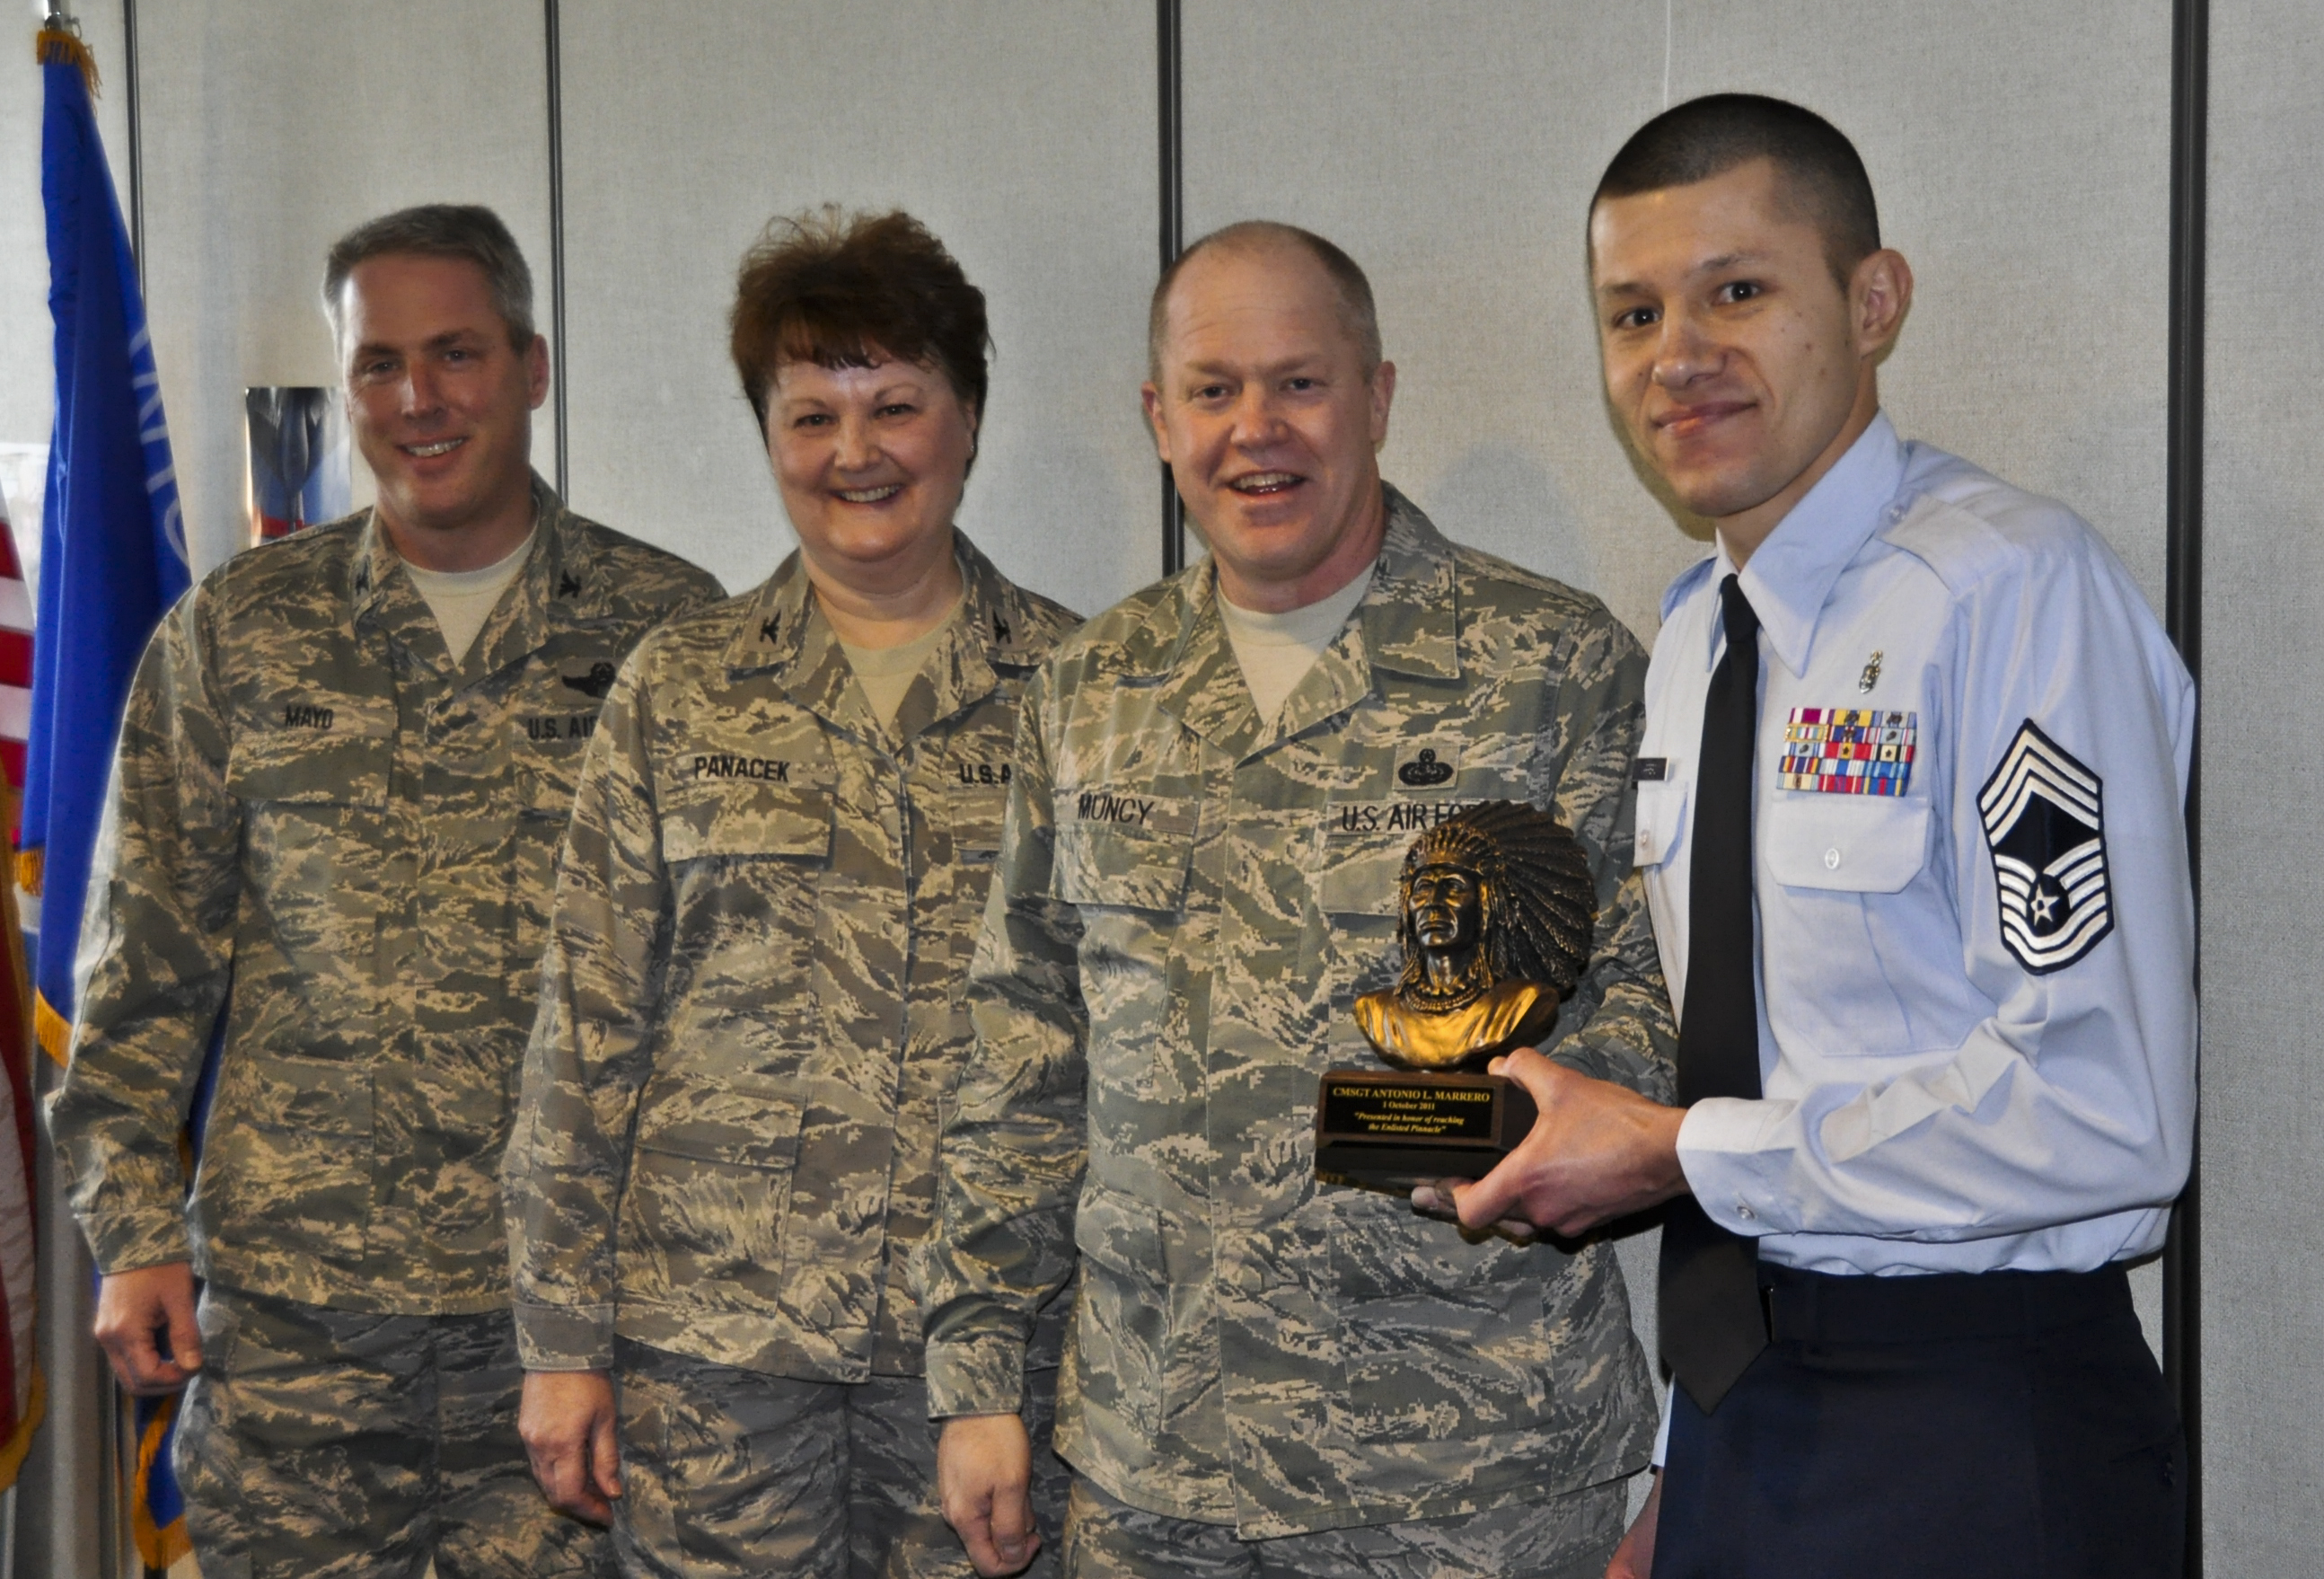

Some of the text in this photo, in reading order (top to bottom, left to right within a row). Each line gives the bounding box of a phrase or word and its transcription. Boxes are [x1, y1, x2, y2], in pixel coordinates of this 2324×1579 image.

[528, 718, 561, 739] U.S.
[695, 755, 790, 782] PANACEK
[959, 763, 999, 784] U.S.
[1078, 793, 1155, 825] MUNCY
[1342, 806, 1380, 832] U.S.
[1387, 804, 1427, 830] AIR
[1333, 1087, 1491, 1103] CMSGT ANTONIO L. MARRERO
[1388, 1101, 1418, 1110] October
[1419, 1102, 1436, 1111] 2011
[1368, 1122, 1380, 1131] the
[1381, 1123, 1410, 1132] Enlisted
[1393, 1113, 1401, 1122] in
[1402, 1114, 1423, 1123] honor
[1424, 1115, 1434, 1125] of
[1433, 1116, 1466, 1126] reaching
